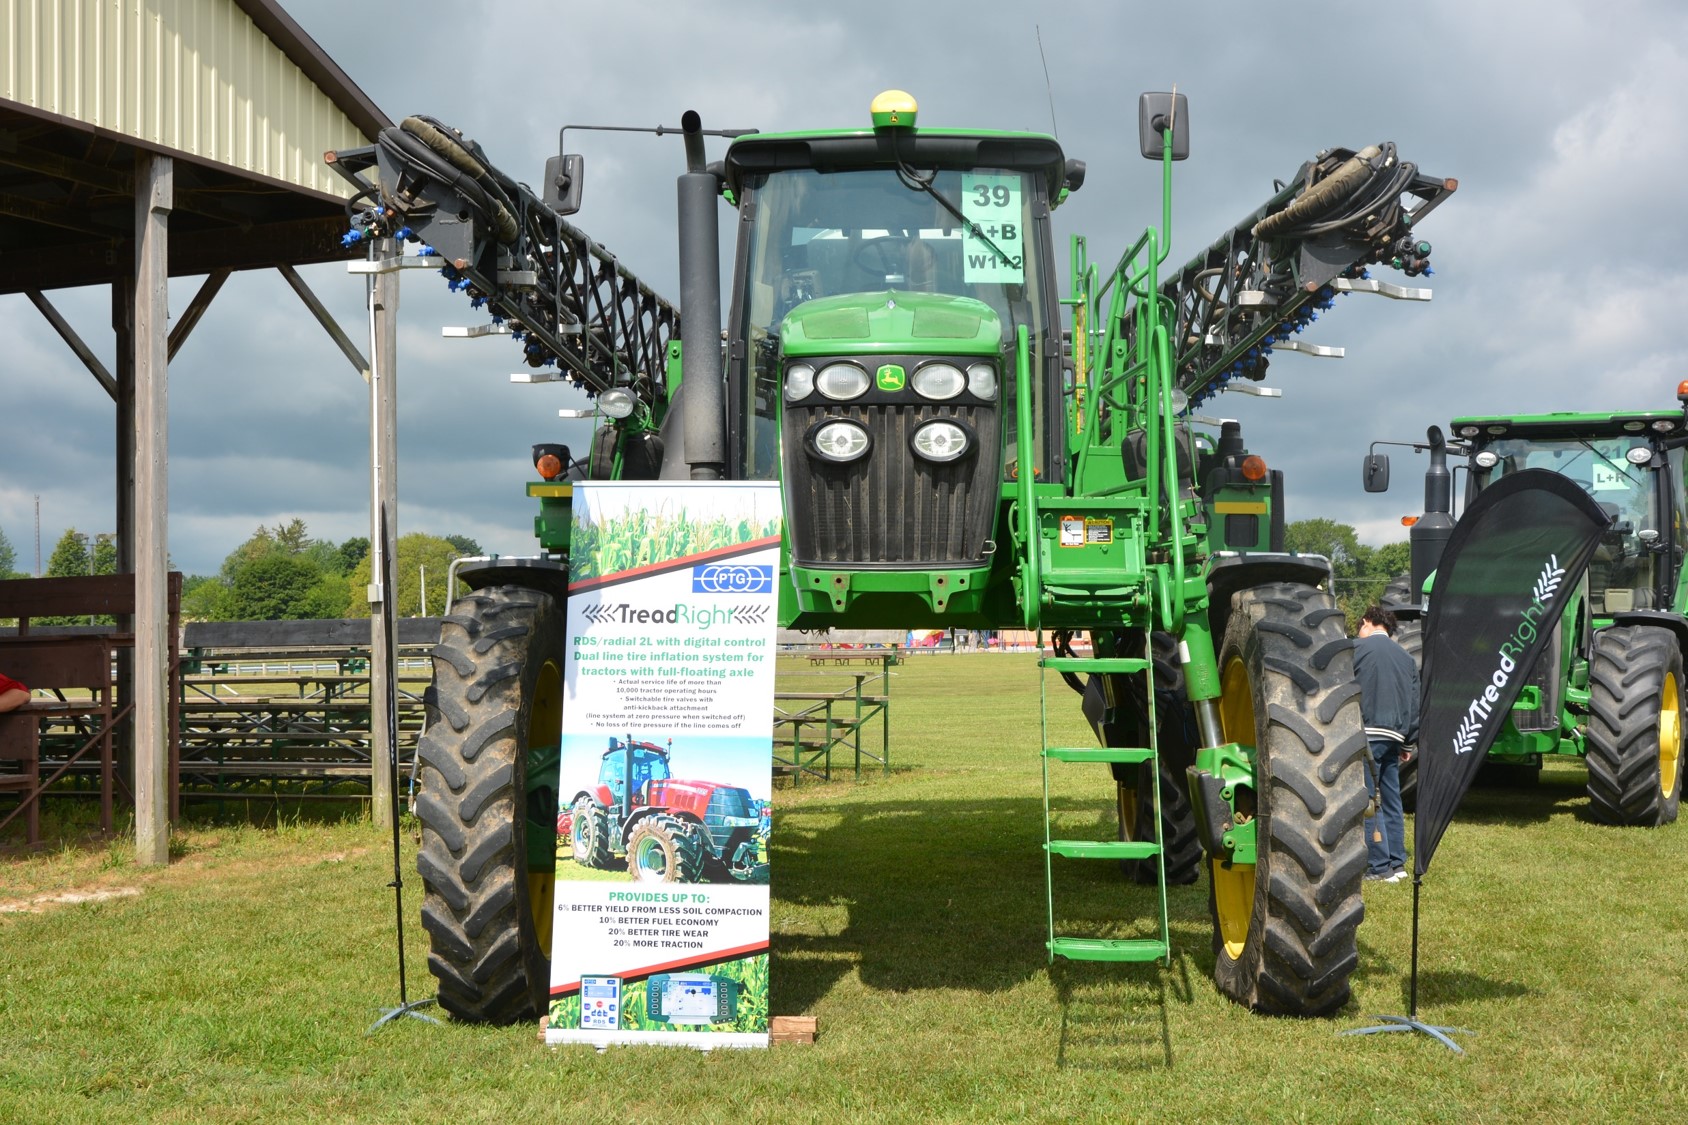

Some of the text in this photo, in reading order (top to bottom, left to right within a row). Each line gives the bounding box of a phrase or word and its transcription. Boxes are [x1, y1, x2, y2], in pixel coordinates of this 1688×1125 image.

[972, 184, 1011, 208] 39
[968, 223, 1017, 241] A+B
[1600, 445, 1621, 460] 21
[1596, 472, 1626, 483] L+R
[719, 573, 746, 585] PTG
[618, 603, 734, 629] TreadRight
[574, 637, 766, 648] RDS/radial 2L with digital control
[574, 652, 764, 664] Dual line tire inflation system for
[582, 666, 754, 678] tractors with full-floating axle
[609, 892, 710, 903] PROVIDES UP TO:
[572, 904, 603, 912] BETTER
[605, 905, 629, 913] YIELD
[705, 908, 763, 916] COMPACTION
[675, 918, 719, 926] ECONOMY
[633, 940, 659, 948] MORE
